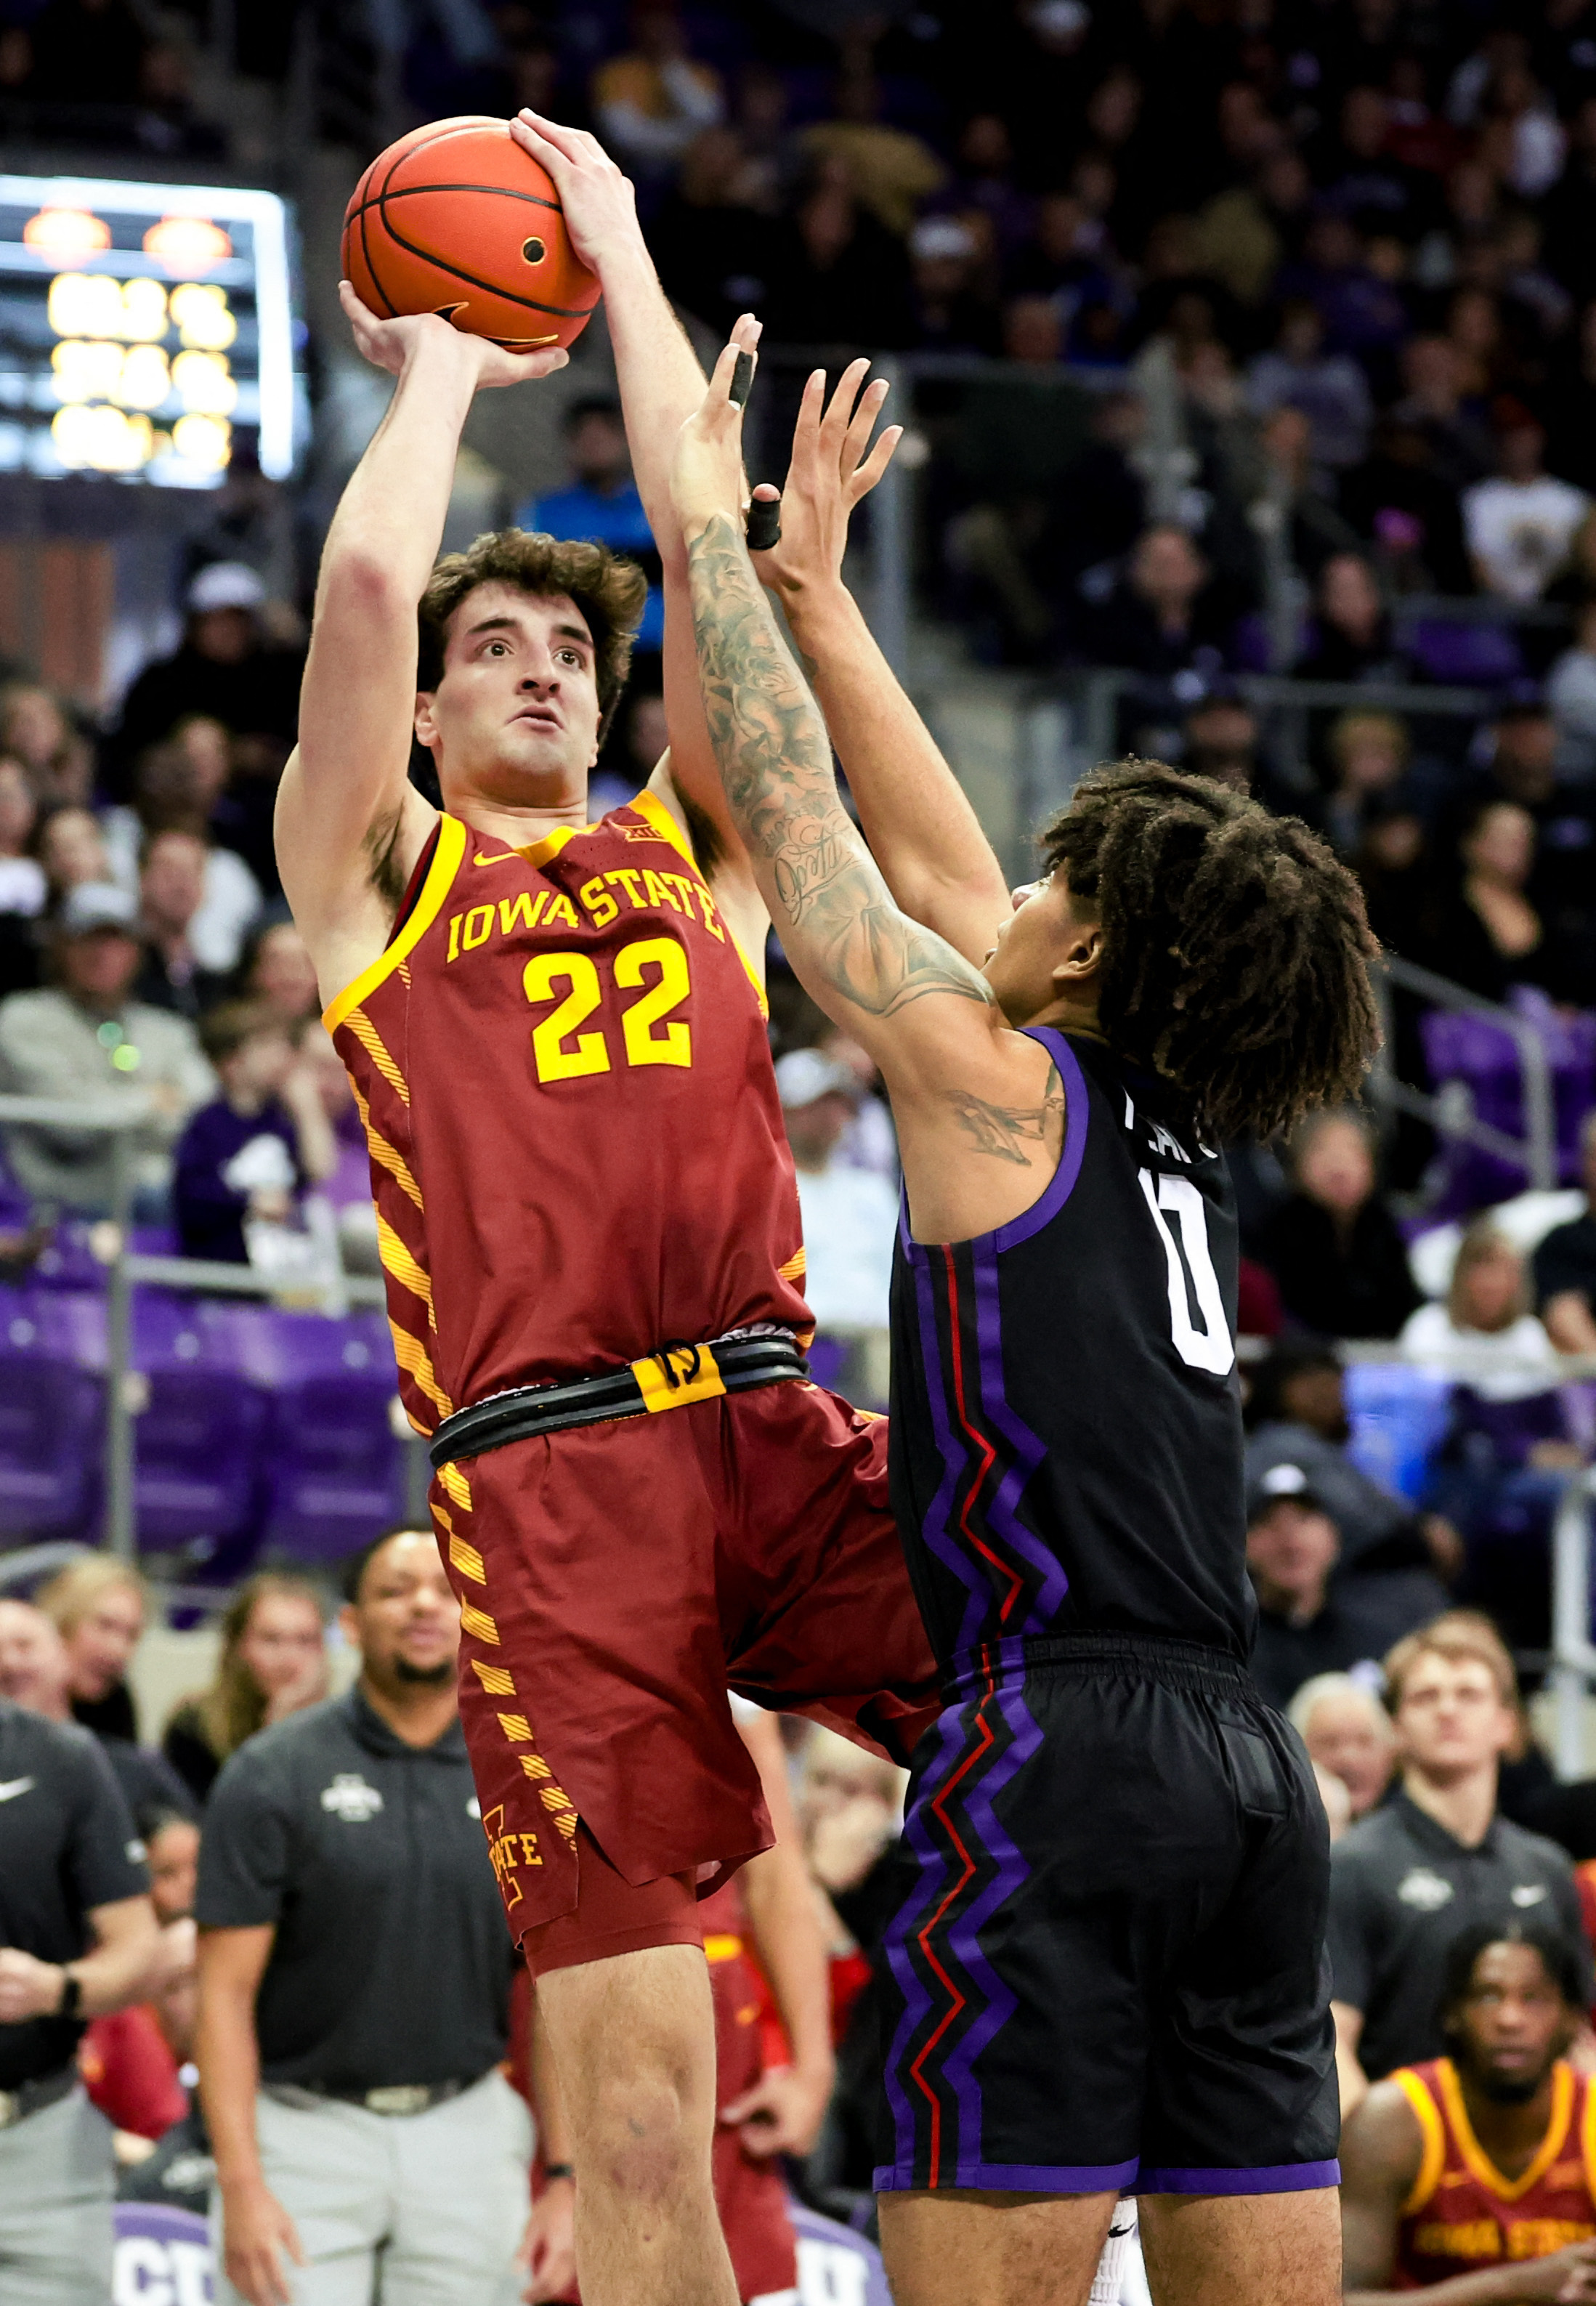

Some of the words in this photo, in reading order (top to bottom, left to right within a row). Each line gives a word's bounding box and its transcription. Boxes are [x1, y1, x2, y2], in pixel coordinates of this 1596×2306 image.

[446, 890, 579, 963] IOWA
[580, 868, 725, 944] STATE
[522, 936, 692, 1084] 22
[1138, 1167, 1235, 1376] 0
